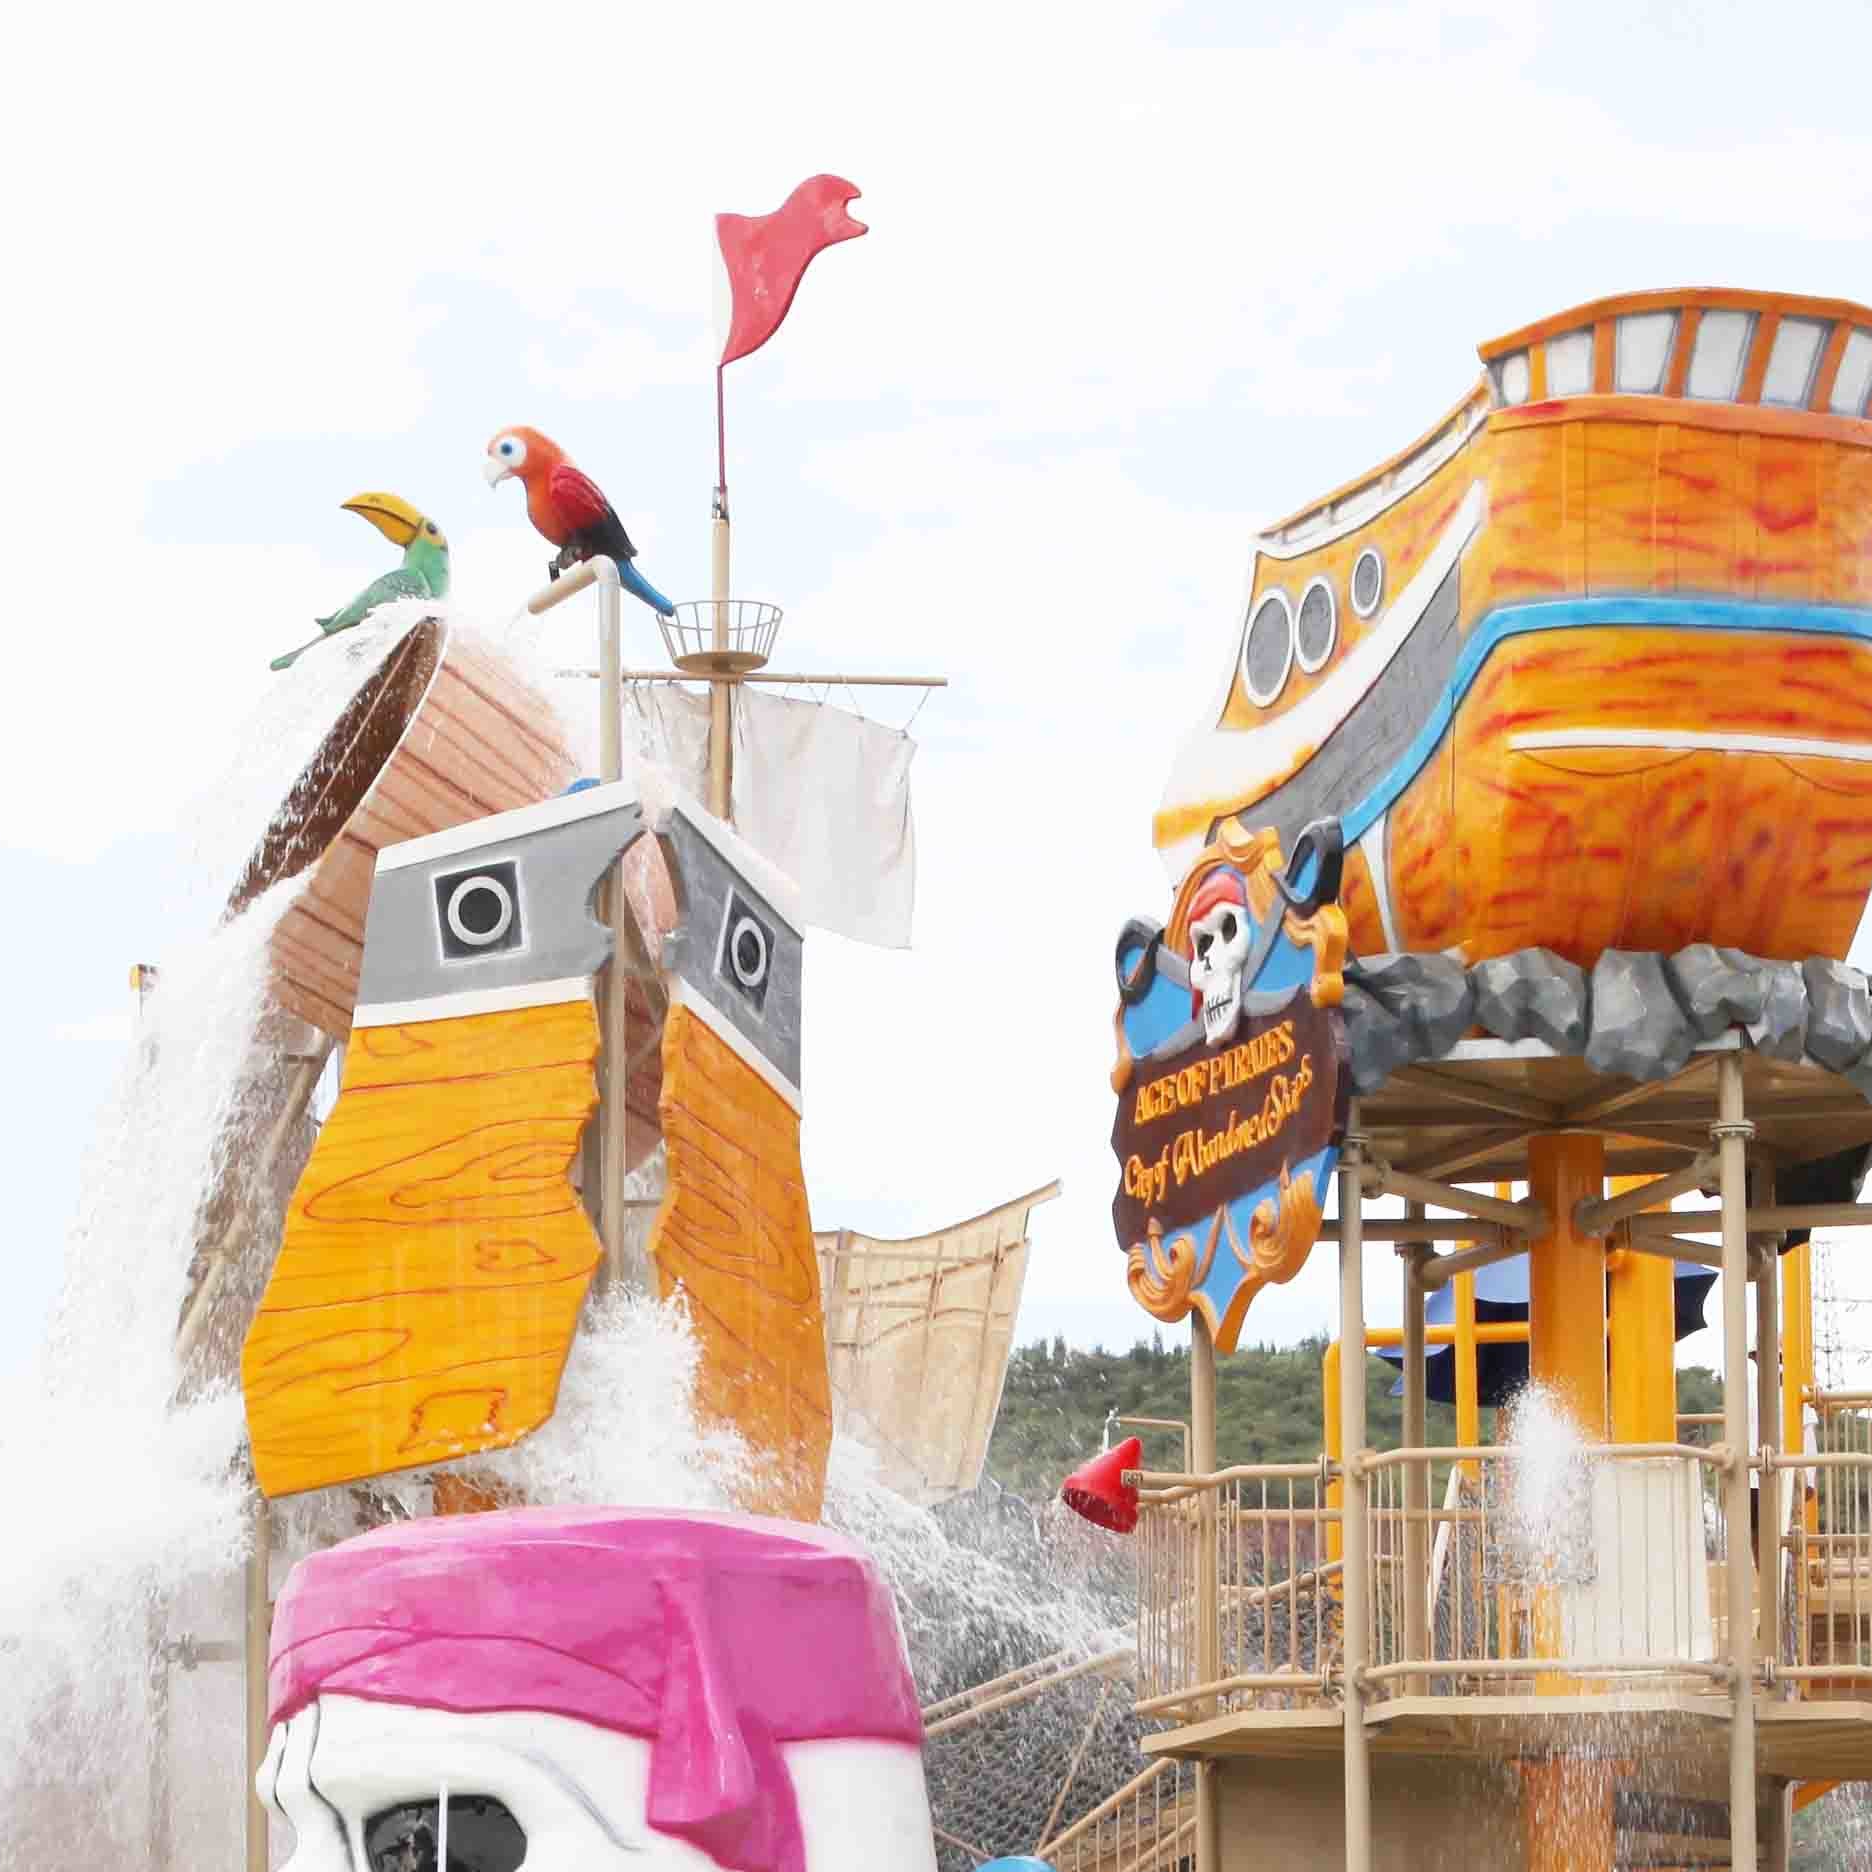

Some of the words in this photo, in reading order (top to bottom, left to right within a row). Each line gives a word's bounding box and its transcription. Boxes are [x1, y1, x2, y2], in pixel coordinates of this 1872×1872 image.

[1135, 1074, 1176, 1124] AGE
[1176, 1060, 1208, 1105] OF
[1208, 1020, 1295, 1095] PIRATES
[1124, 1154, 1153, 1208] City
[1153, 1143, 1170, 1202] of
